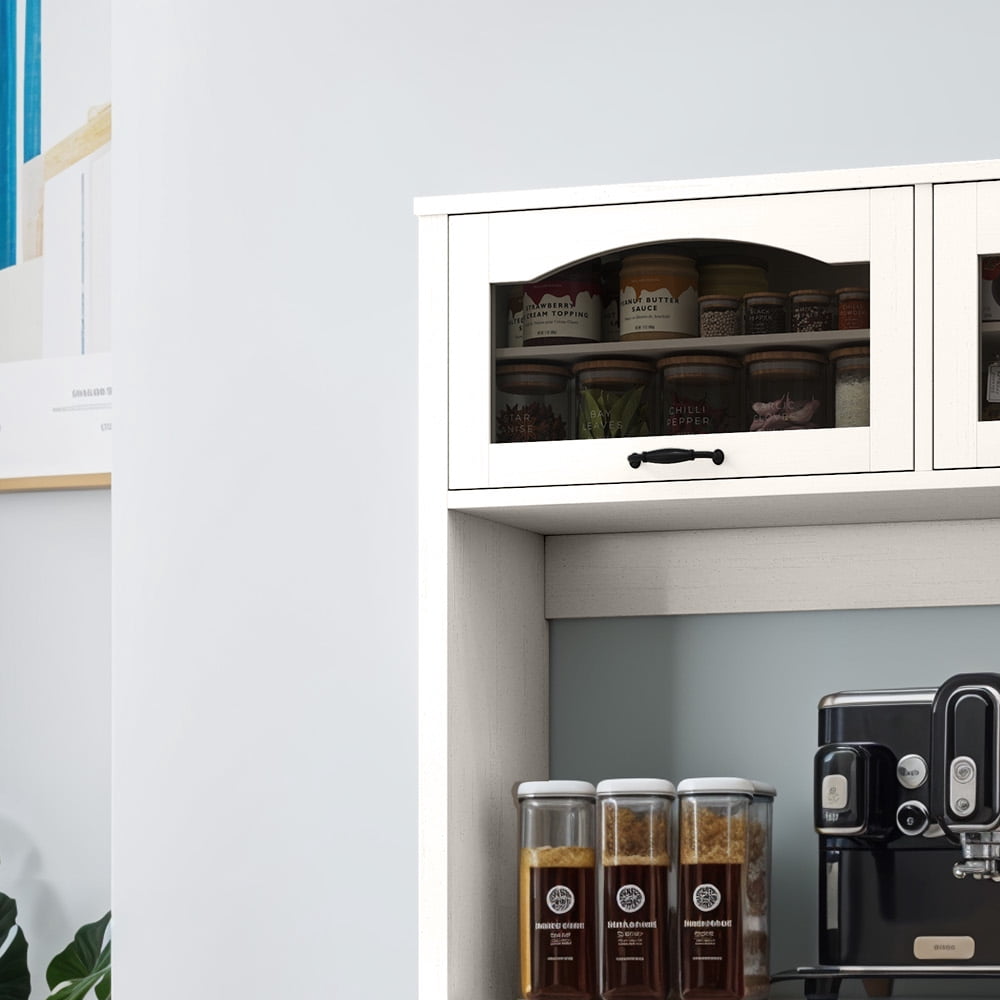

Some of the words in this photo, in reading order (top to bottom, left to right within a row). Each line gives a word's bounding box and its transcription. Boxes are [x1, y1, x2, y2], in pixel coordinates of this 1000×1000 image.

[645, 297, 680, 305] BUTTER
[551, 310, 590, 319] TOPPING
[631, 305, 658, 313] SAUCE
[590, 408, 612, 419] BAY
[669, 405, 705, 416] CHILLI
[583, 420, 623, 431] LEAVES
[666, 416, 710, 427] PEPPER
